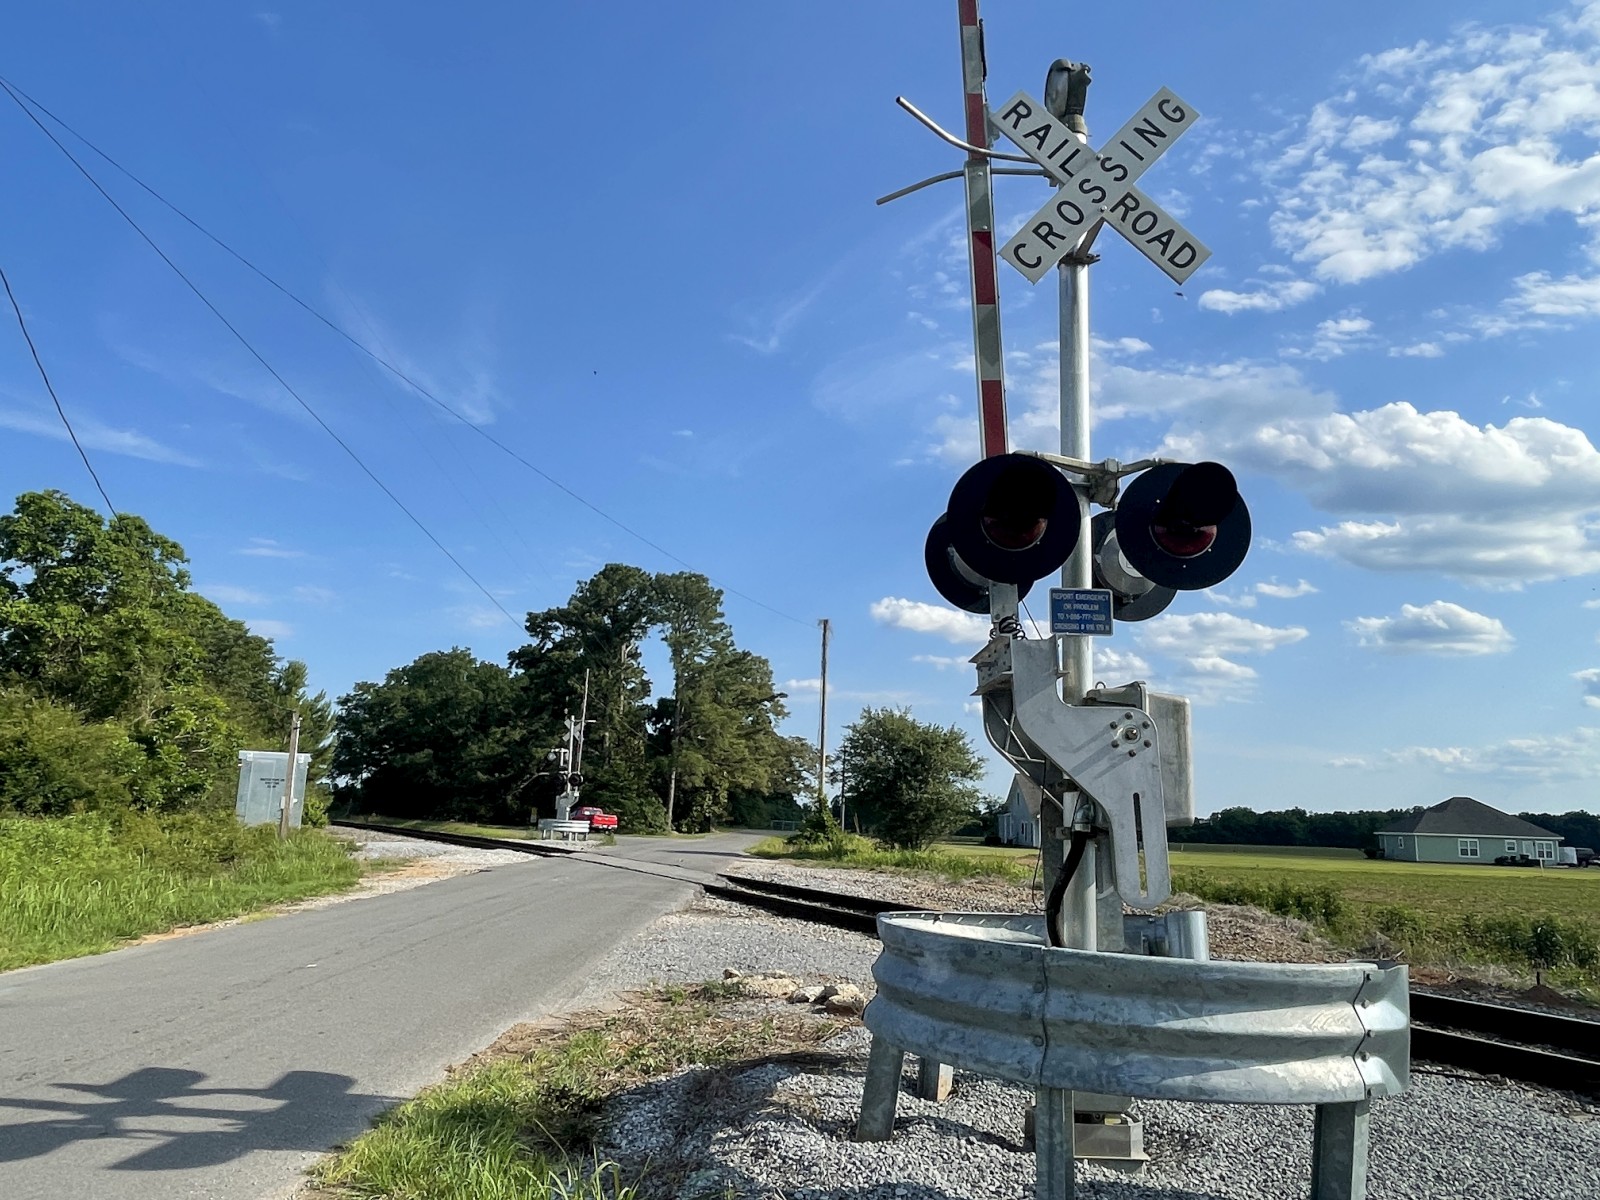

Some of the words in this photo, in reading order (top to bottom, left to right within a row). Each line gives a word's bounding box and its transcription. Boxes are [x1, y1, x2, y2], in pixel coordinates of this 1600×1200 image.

[1001, 99, 1081, 178] RAIL
[1109, 191, 1197, 269] ROAD
[1013, 98, 1186, 269] CROSSING
[1052, 592, 1074, 600] REPORT
[1075, 593, 1109, 601] EMERGENCY
[1063, 602, 1072, 610] OR
[1054, 622, 1080, 630] CROSSING
